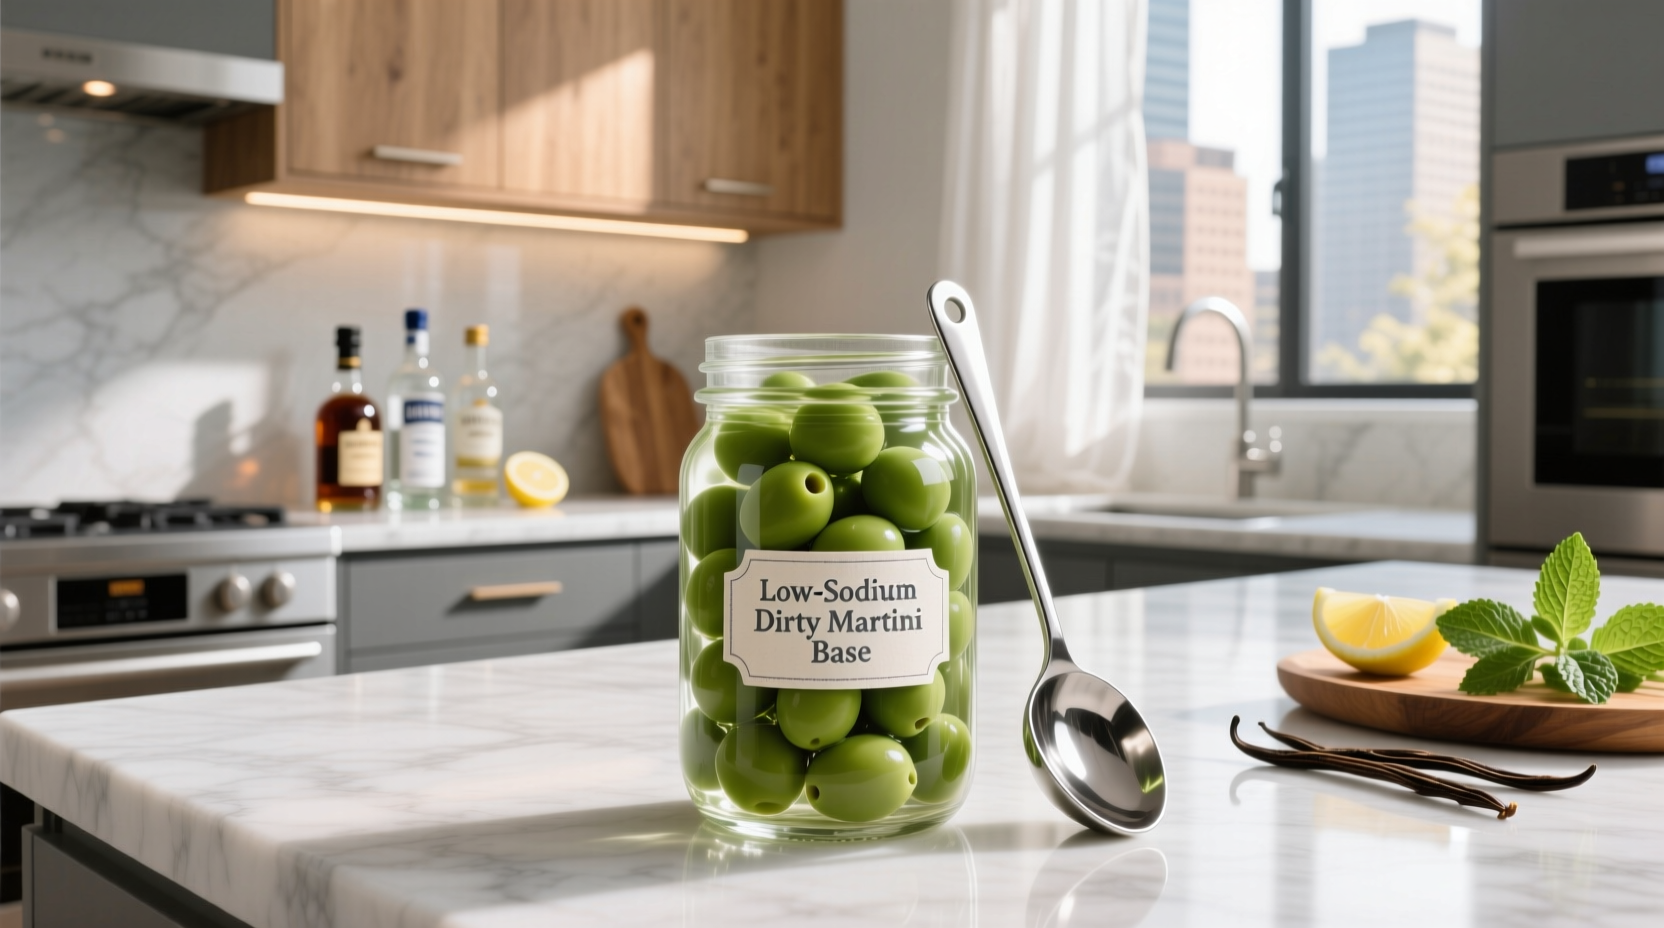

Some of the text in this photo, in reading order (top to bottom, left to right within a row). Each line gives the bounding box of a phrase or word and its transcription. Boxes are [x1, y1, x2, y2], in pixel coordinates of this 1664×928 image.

[759, 578, 918, 603] Low-Sodium
[753, 607, 924, 640] Dirty Martini
[811, 640, 872, 664] Base
